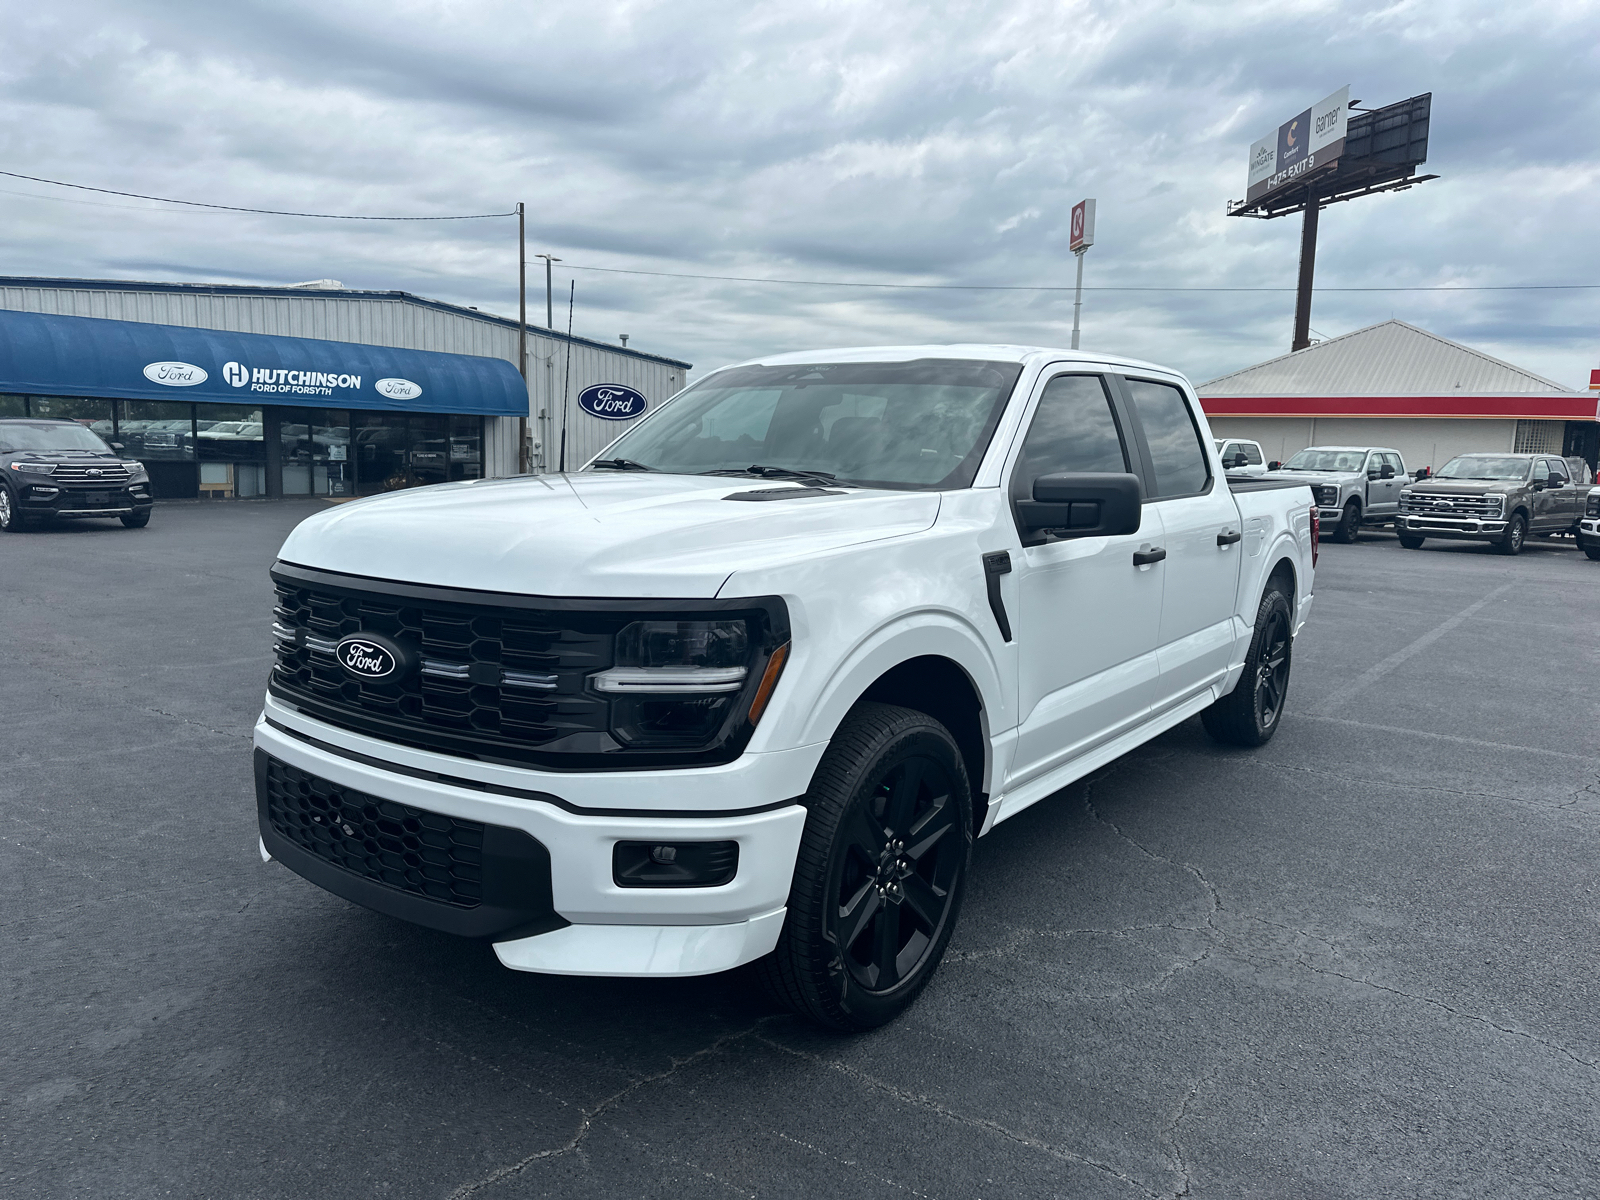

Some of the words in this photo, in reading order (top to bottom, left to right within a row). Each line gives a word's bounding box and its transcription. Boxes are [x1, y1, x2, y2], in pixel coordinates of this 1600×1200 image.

[1315, 106, 1341, 135] Garner
[1250, 150, 1275, 172] WINGATE
[1283, 146, 1300, 160] Comfort
[1288, 158, 1308, 178] EXIT
[1308, 154, 1315, 168] 9
[157, 366, 195, 382] Ford
[252, 367, 362, 390] HUTCHINSON
[251, 383, 277, 393] FORD
[278, 384, 291, 393] OF
[291, 385, 333, 396] FORSYTH
[384, 381, 412, 396] Ford
[593, 388, 634, 413] Ford
[346, 643, 383, 672] Ford
